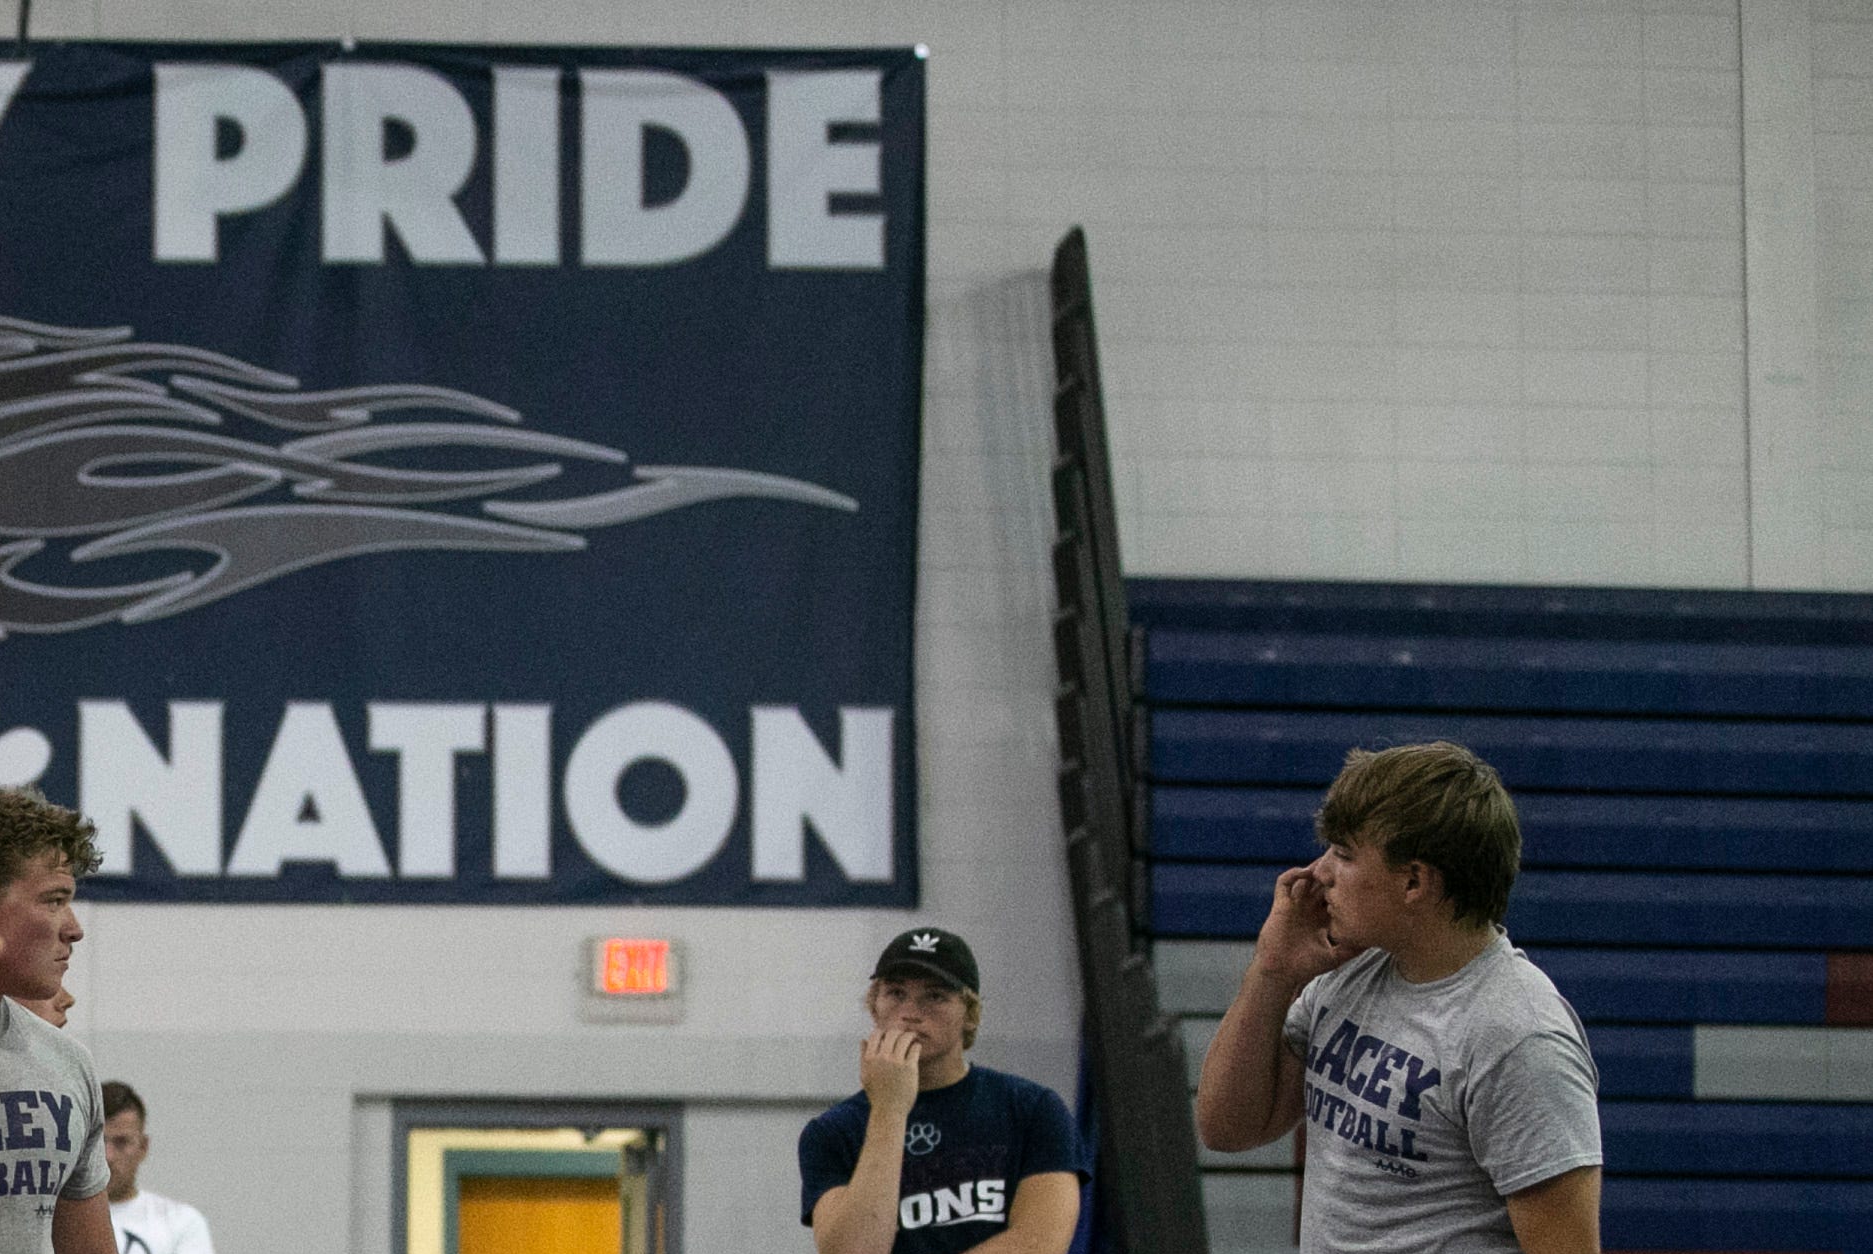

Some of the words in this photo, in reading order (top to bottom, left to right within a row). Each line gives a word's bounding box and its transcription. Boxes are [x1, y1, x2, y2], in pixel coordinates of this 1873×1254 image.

[152, 61, 887, 271] PRIDE
[78, 698, 895, 884] NATION
[1306, 1080, 1428, 1162] OOTBALL
[899, 1178, 1006, 1230] ONS
